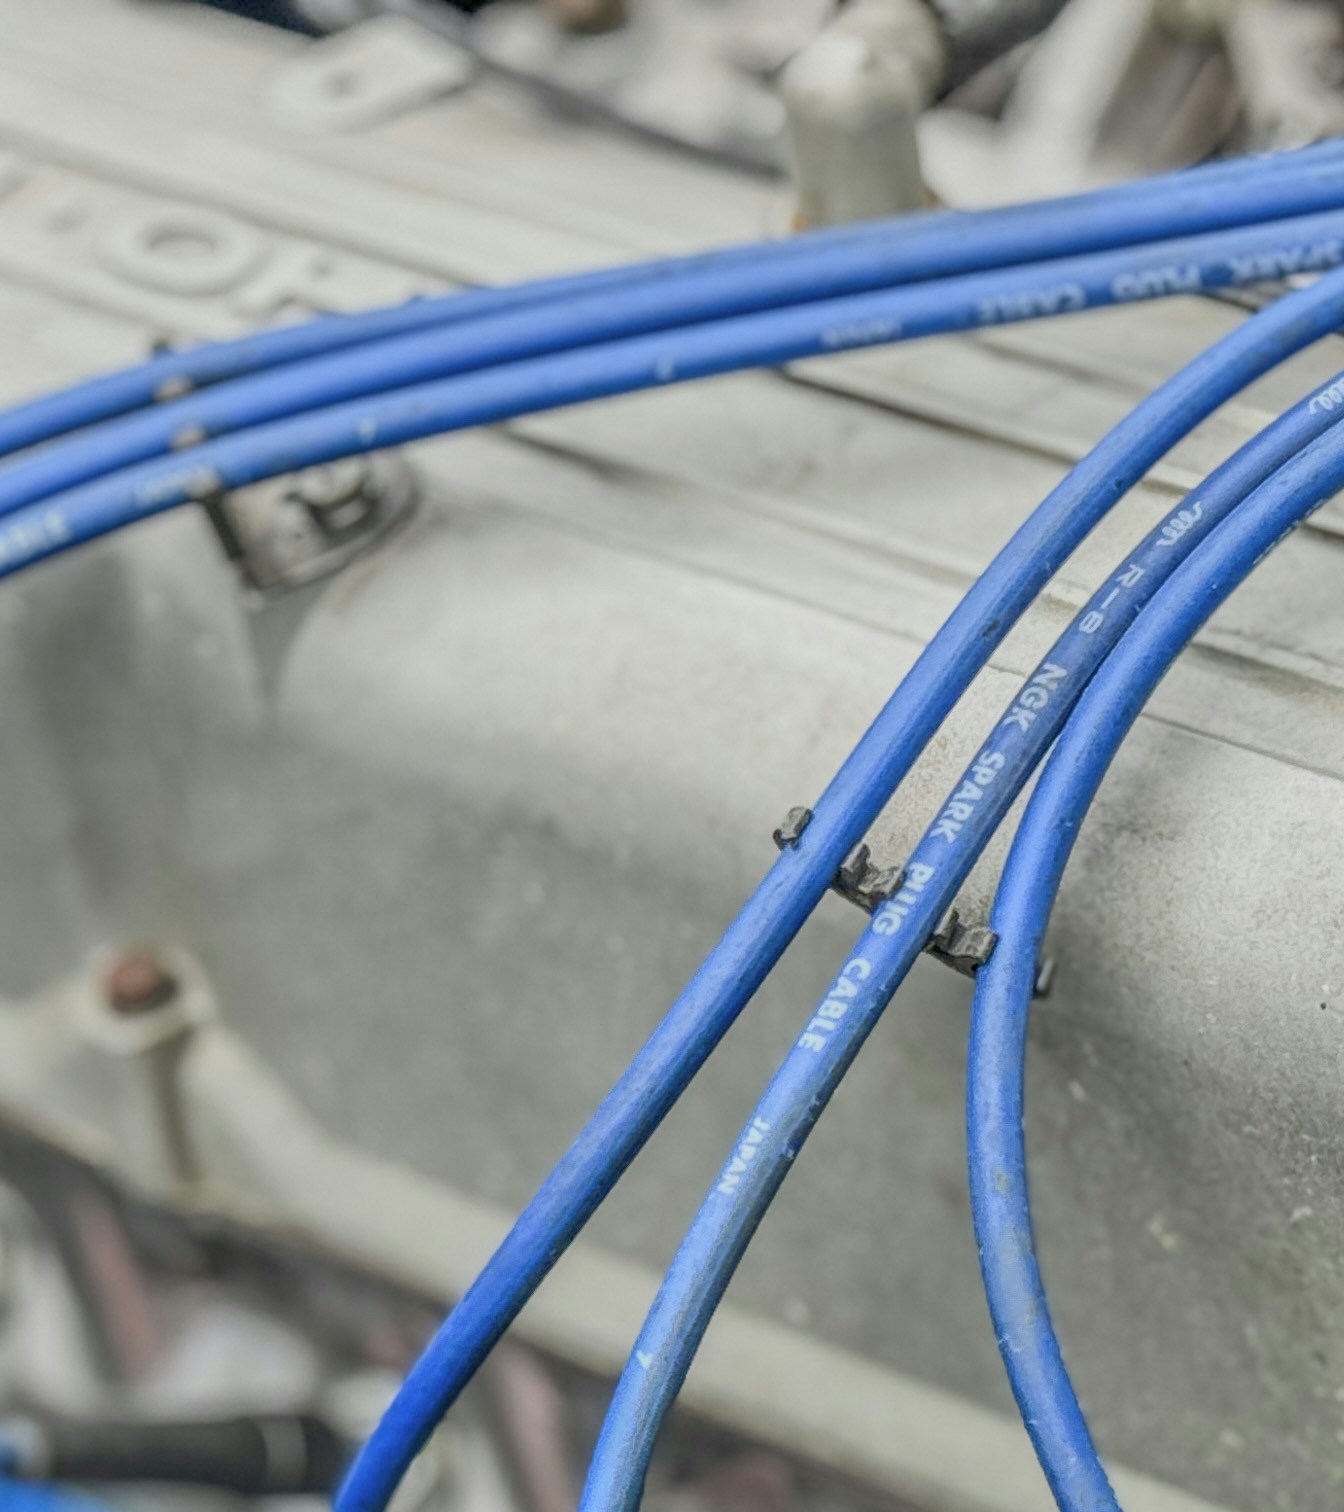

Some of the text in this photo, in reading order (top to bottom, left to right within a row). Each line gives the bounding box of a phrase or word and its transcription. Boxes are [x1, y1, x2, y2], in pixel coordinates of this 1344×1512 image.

[718, 563, 1147, 1196] R-8 NGK SPARK PLUG CABLE JAPAN
